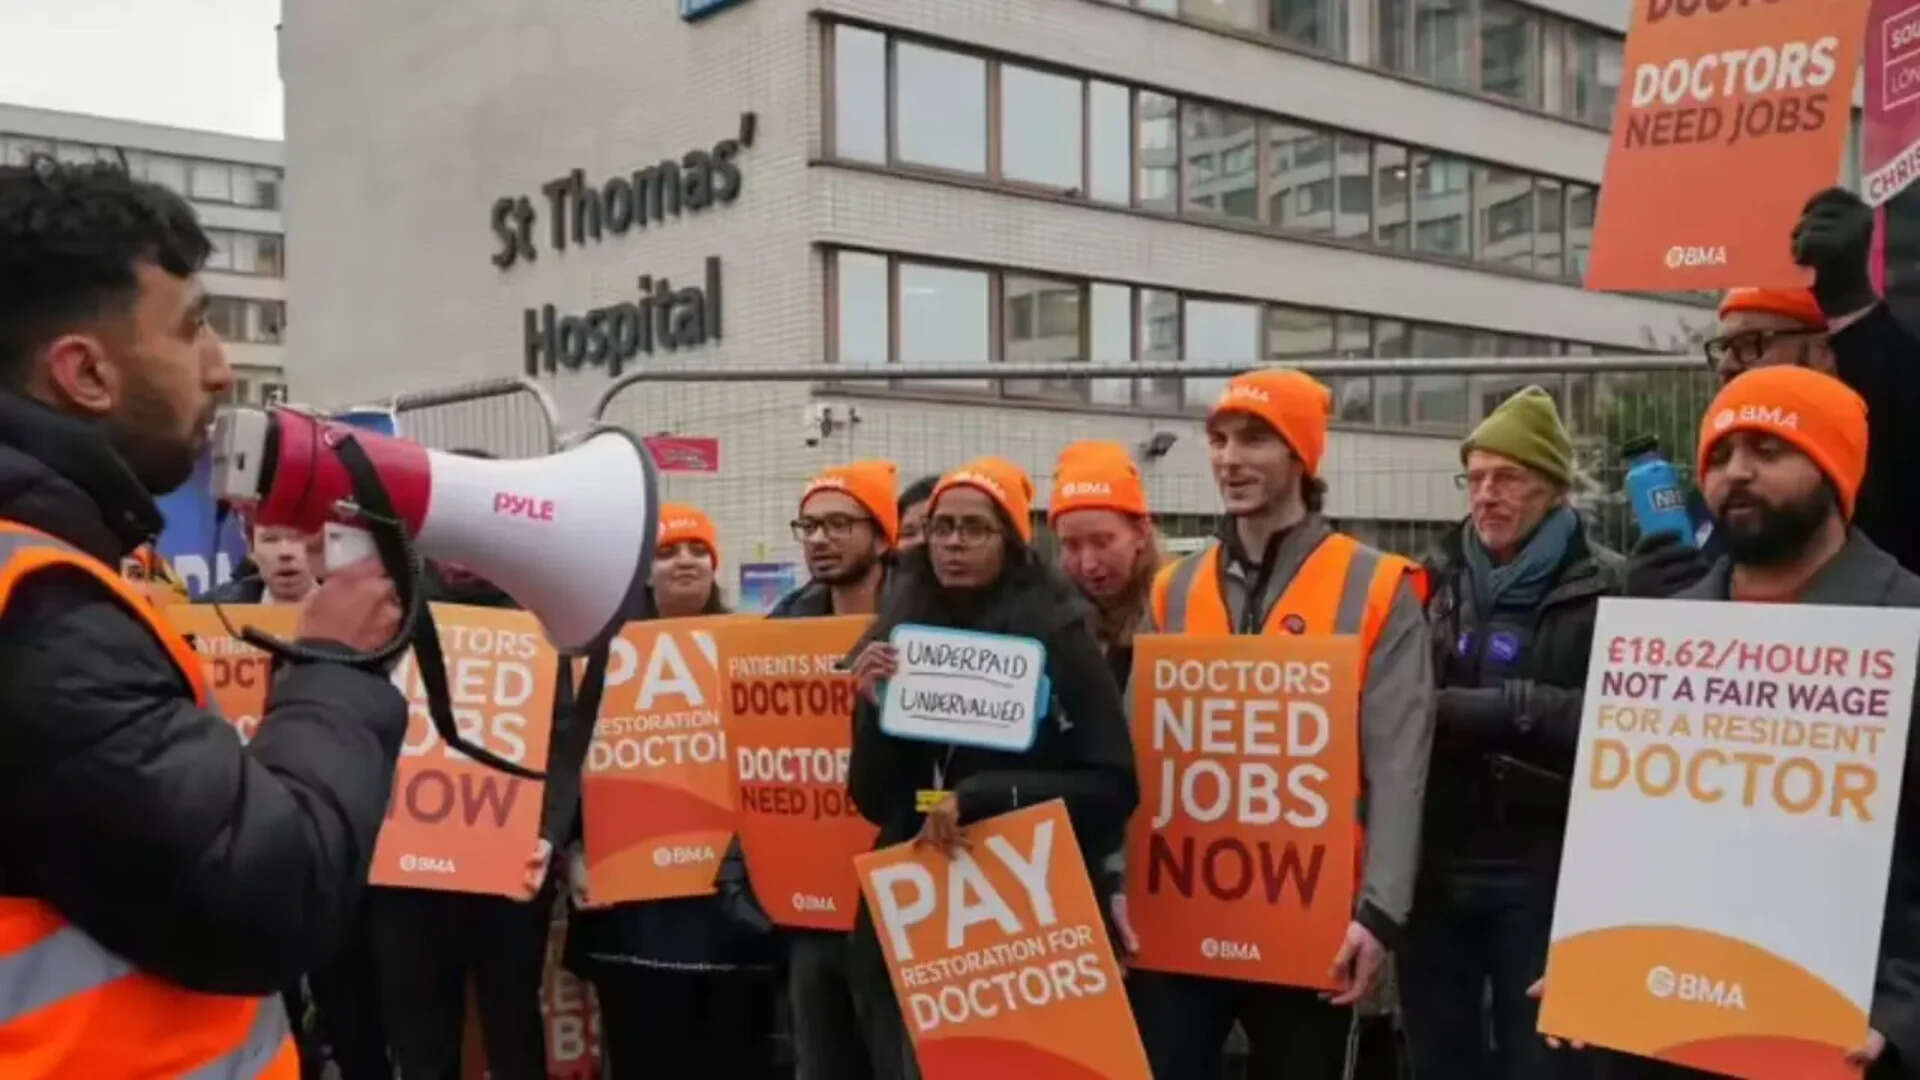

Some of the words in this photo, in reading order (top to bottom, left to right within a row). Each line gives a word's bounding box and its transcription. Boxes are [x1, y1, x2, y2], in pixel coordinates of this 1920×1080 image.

[1632, 36, 1839, 108] DOCTORS
[1624, 106, 1723, 148] NEED
[1726, 93, 1829, 146] JOBS
[490, 195, 537, 270] St
[1683, 246, 1728, 267] BMA
[523, 256, 723, 378] Hospital
[1740, 403, 1798, 432] BMA
[494, 491, 554, 521] PYLE
[907, 640, 1029, 679] UNDERPAID
[1154, 659, 1332, 695] DOCTORS
[1607, 635, 1850, 678] £18.62/HOUR
[1859, 649, 1896, 680] IS
[730, 679, 858, 717] DOCTOR
[901, 686, 1026, 723] UNDERVALUED
[1601, 671, 1668, 700] NOT
[1672, 675, 1695, 703] A
[1703, 677, 1779, 709] FAIR
[1788, 683, 1891, 718] WAGE
[401, 700, 529, 765] OBS
[596, 709, 720, 736] ESTORATION
[1153, 698, 1331, 758] NEED
[1597, 703, 1662, 734] FOR
[1668, 713, 1693, 738] A
[1702, 713, 1887, 756] RESIDENT
[588, 730, 728, 772] DOCTO
[736, 745, 852, 786] DOCTOR
[388, 767, 523, 829] OW
[741, 785, 807, 815] NEED
[1151, 758, 1330, 830] JOBS
[1588, 738, 1880, 823] DOCTOR
[870, 819, 1057, 962] PAY
[1147, 833, 1327, 910] NOW
[901, 936, 1046, 988] RESTORATION
[1049, 924, 1094, 954] FOR
[1219, 940, 1262, 961] BMA
[909, 952, 1108, 1033] DOCTORS
[1676, 973, 1747, 1011] BMA
